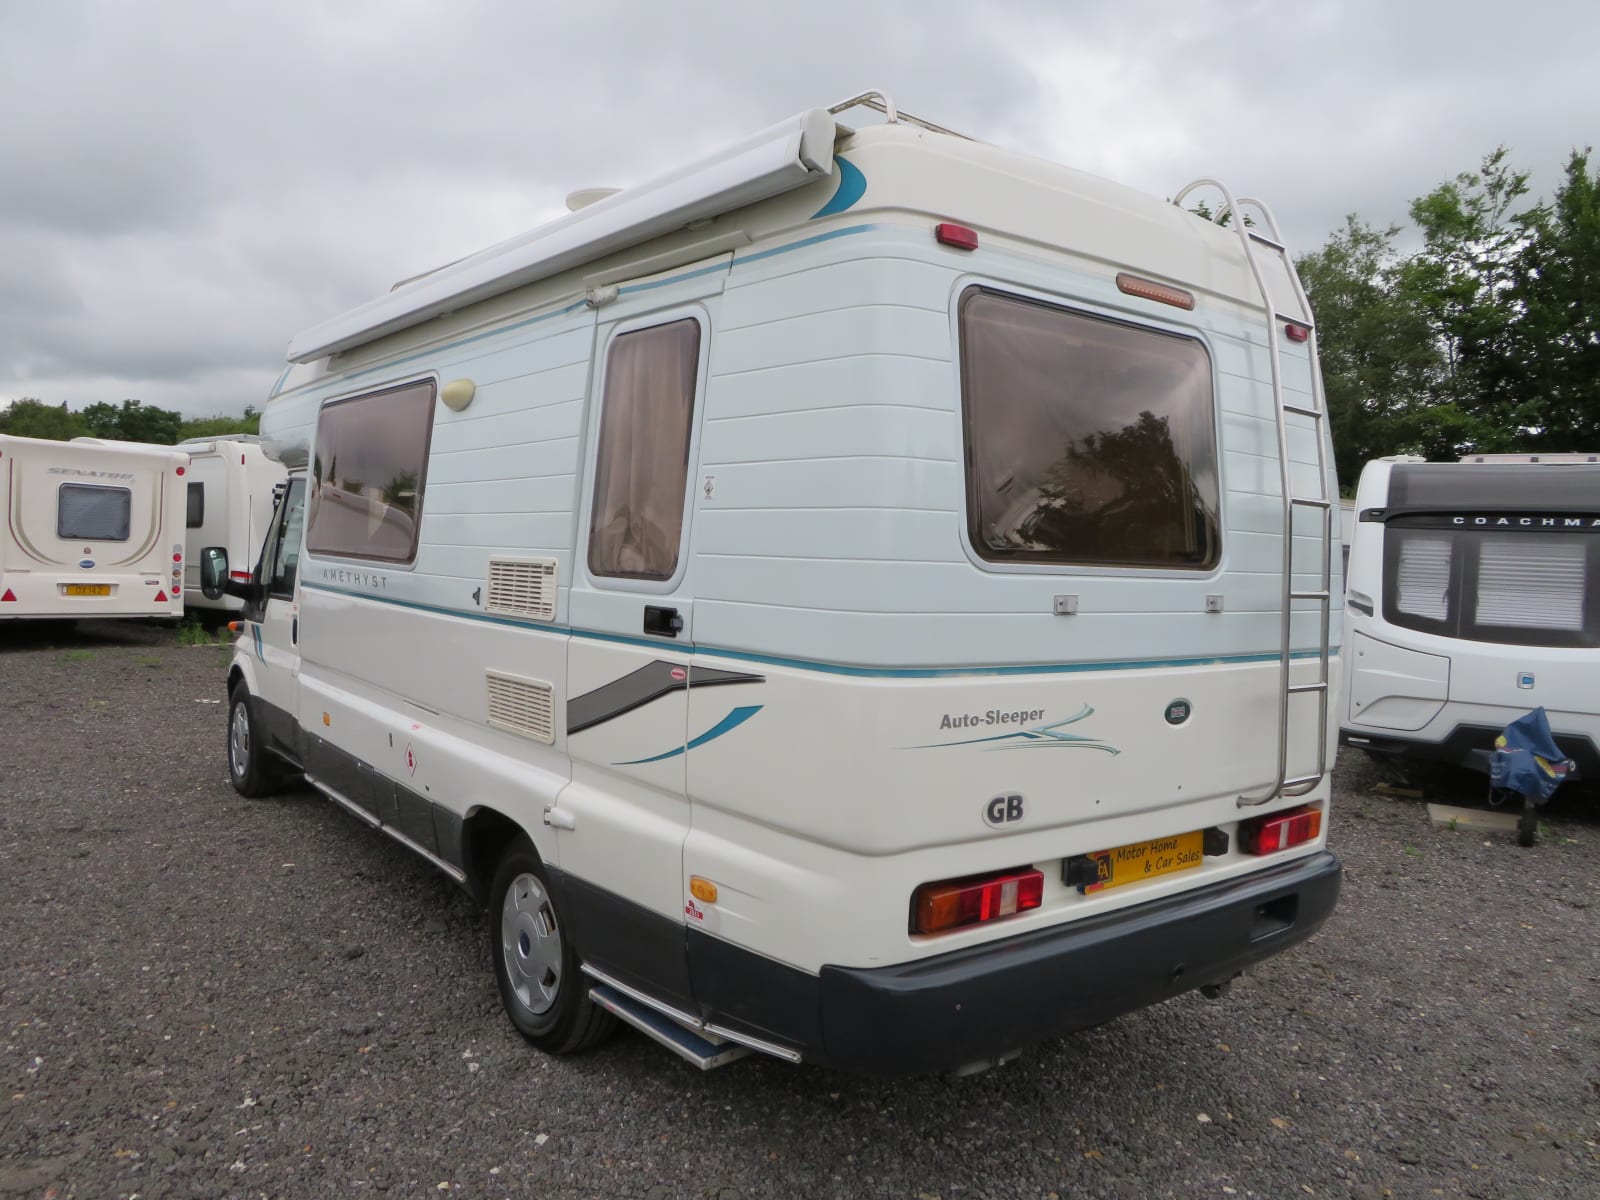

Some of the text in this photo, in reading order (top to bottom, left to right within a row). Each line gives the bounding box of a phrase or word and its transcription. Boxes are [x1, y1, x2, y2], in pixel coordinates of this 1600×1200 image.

[323, 567, 387, 588] AMETHYST
[939, 708, 1045, 730] Auto-Sleeper
[987, 795, 1024, 824] GB
[1117, 839, 1178, 862] Motor Home
[1144, 847, 1200, 873] & Car Sales
